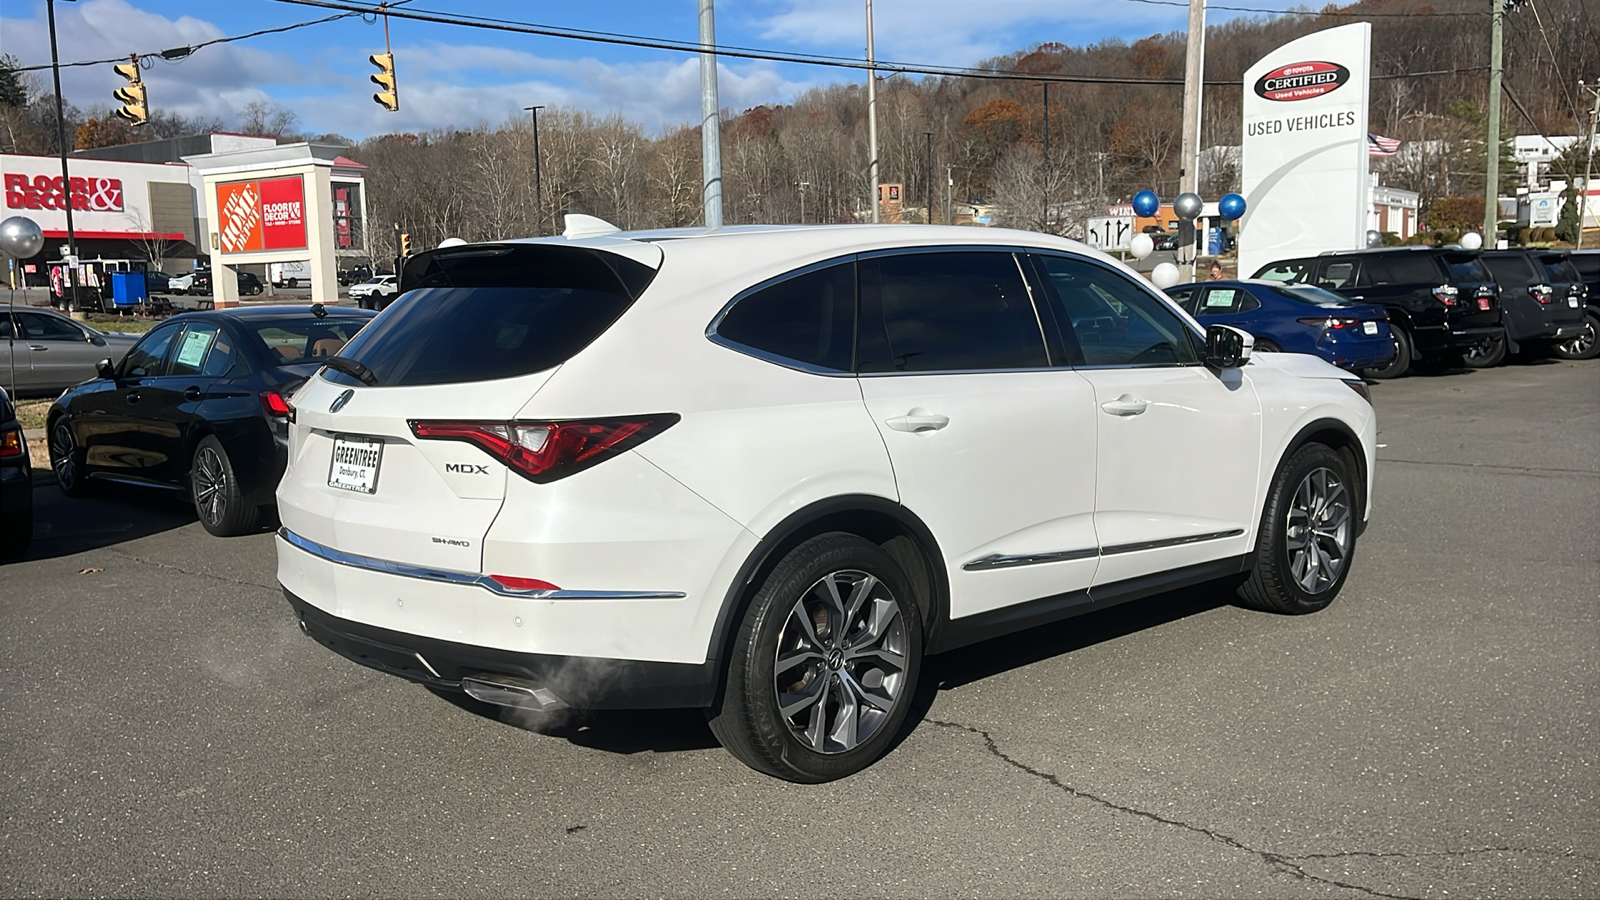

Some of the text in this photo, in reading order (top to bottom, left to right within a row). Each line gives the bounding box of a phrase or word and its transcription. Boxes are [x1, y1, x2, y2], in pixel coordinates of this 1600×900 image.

[1292, 66, 1314, 74] TOYOTA
[1264, 72, 1338, 91] CERTIFIED
[1275, 87, 1325, 99] Used Vehicles
[1248, 111, 1355, 136] USED VEHICLES
[3, 173, 124, 212] FLOOR &
[5, 191, 92, 212] DECOR
[223, 189, 241, 219] THE
[263, 201, 301, 220] FLOOR &
[221, 183, 259, 252] HOME
[264, 212, 290, 222] DECOR
[236, 206, 260, 252] DEPOT
[335, 446, 378, 468] GREENTREE
[445, 463, 490, 475] MDX
